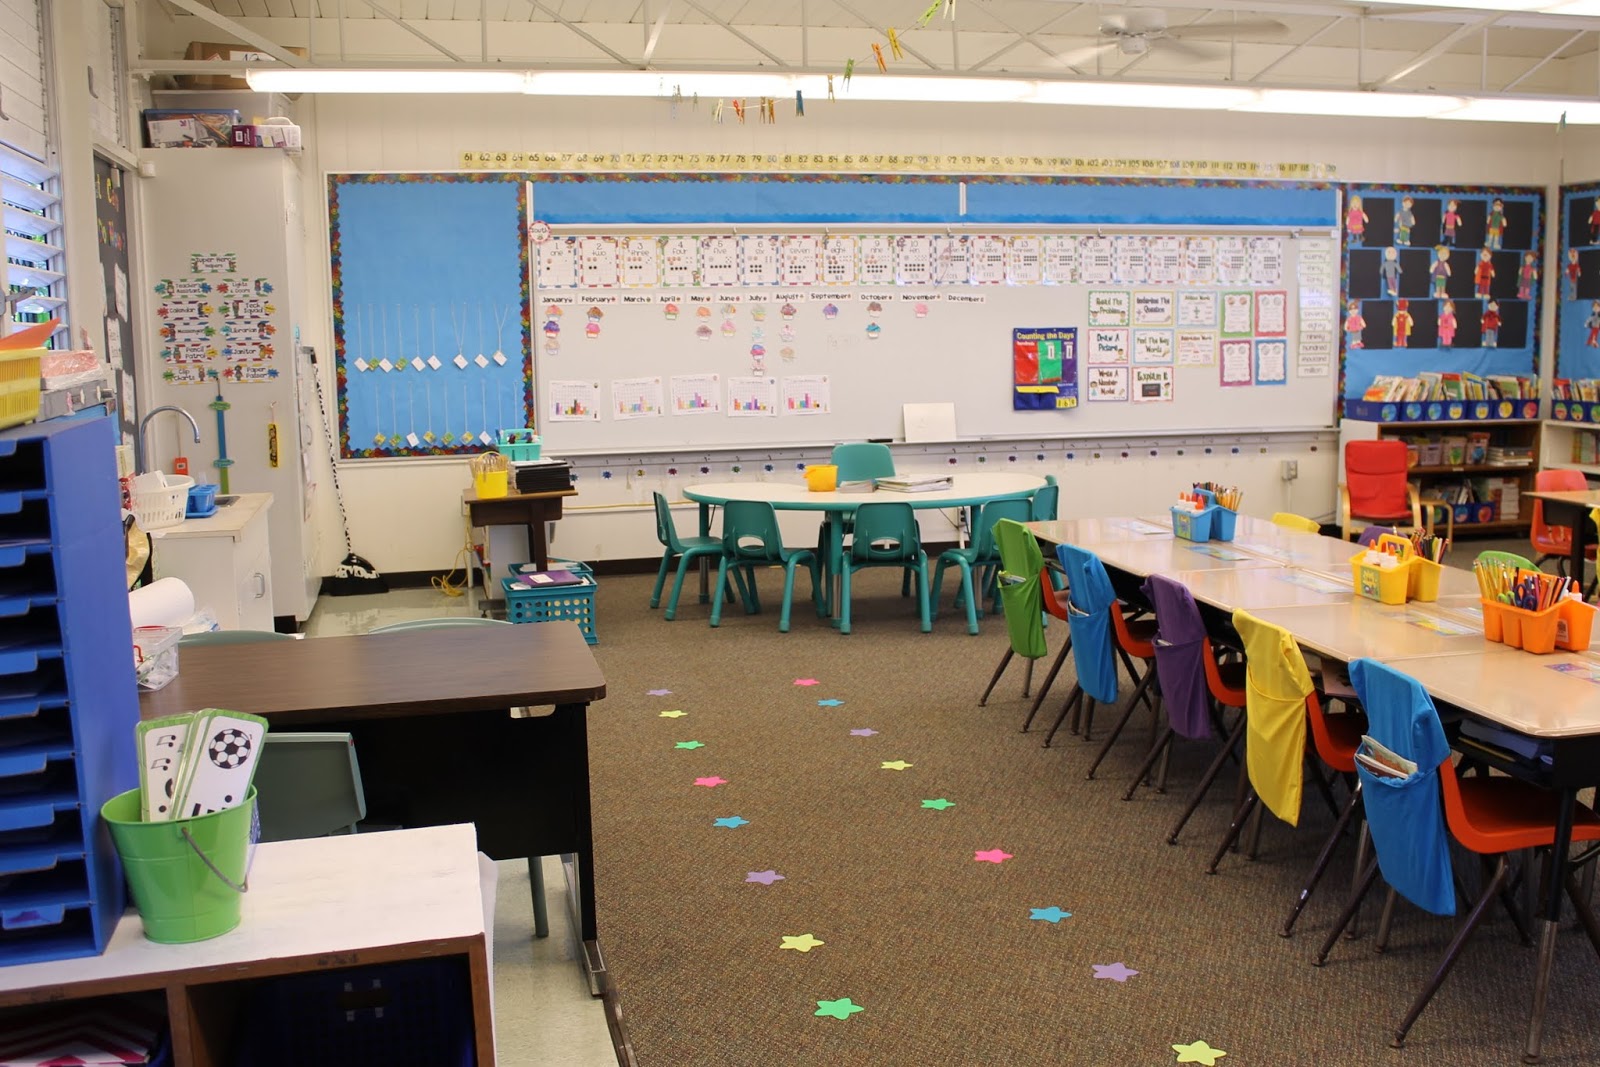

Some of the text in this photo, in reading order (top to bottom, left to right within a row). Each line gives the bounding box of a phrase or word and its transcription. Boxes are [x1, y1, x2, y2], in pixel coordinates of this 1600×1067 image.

[577, 154, 588, 162] 68
[594, 154, 604, 162] 69
[610, 154, 620, 162] 70
[627, 154, 635, 162] 71
[641, 154, 651, 162] 72
[799, 155, 808, 163] 82
[814, 155, 823, 163] 83
[828, 155, 838, 163] 84
[844, 155, 853, 163] 85
[859, 155, 868, 163] 86
[904, 156, 913, 164] 89
[934, 156, 941, 164] 91
[947, 156, 957, 164] 92
[962, 156, 971, 164] 93
[976, 156, 985, 164] 94
[1005, 157, 1014, 165] 96
[1020, 157, 1029, 165] 97
[1034, 157, 1043, 165] 98
[1048, 158, 1057, 166] 99
[775, 294, 799, 302] August
[1144, 305, 1165, 313] Question
[1017, 332, 1045, 340] Counting
[1097, 333, 1119, 342] Draw A
[1098, 343, 1118, 351] Picture
[1145, 345, 1162, 353] Words
[1098, 369, 1112, 377] Write
[1137, 371, 1162, 381] Explain
